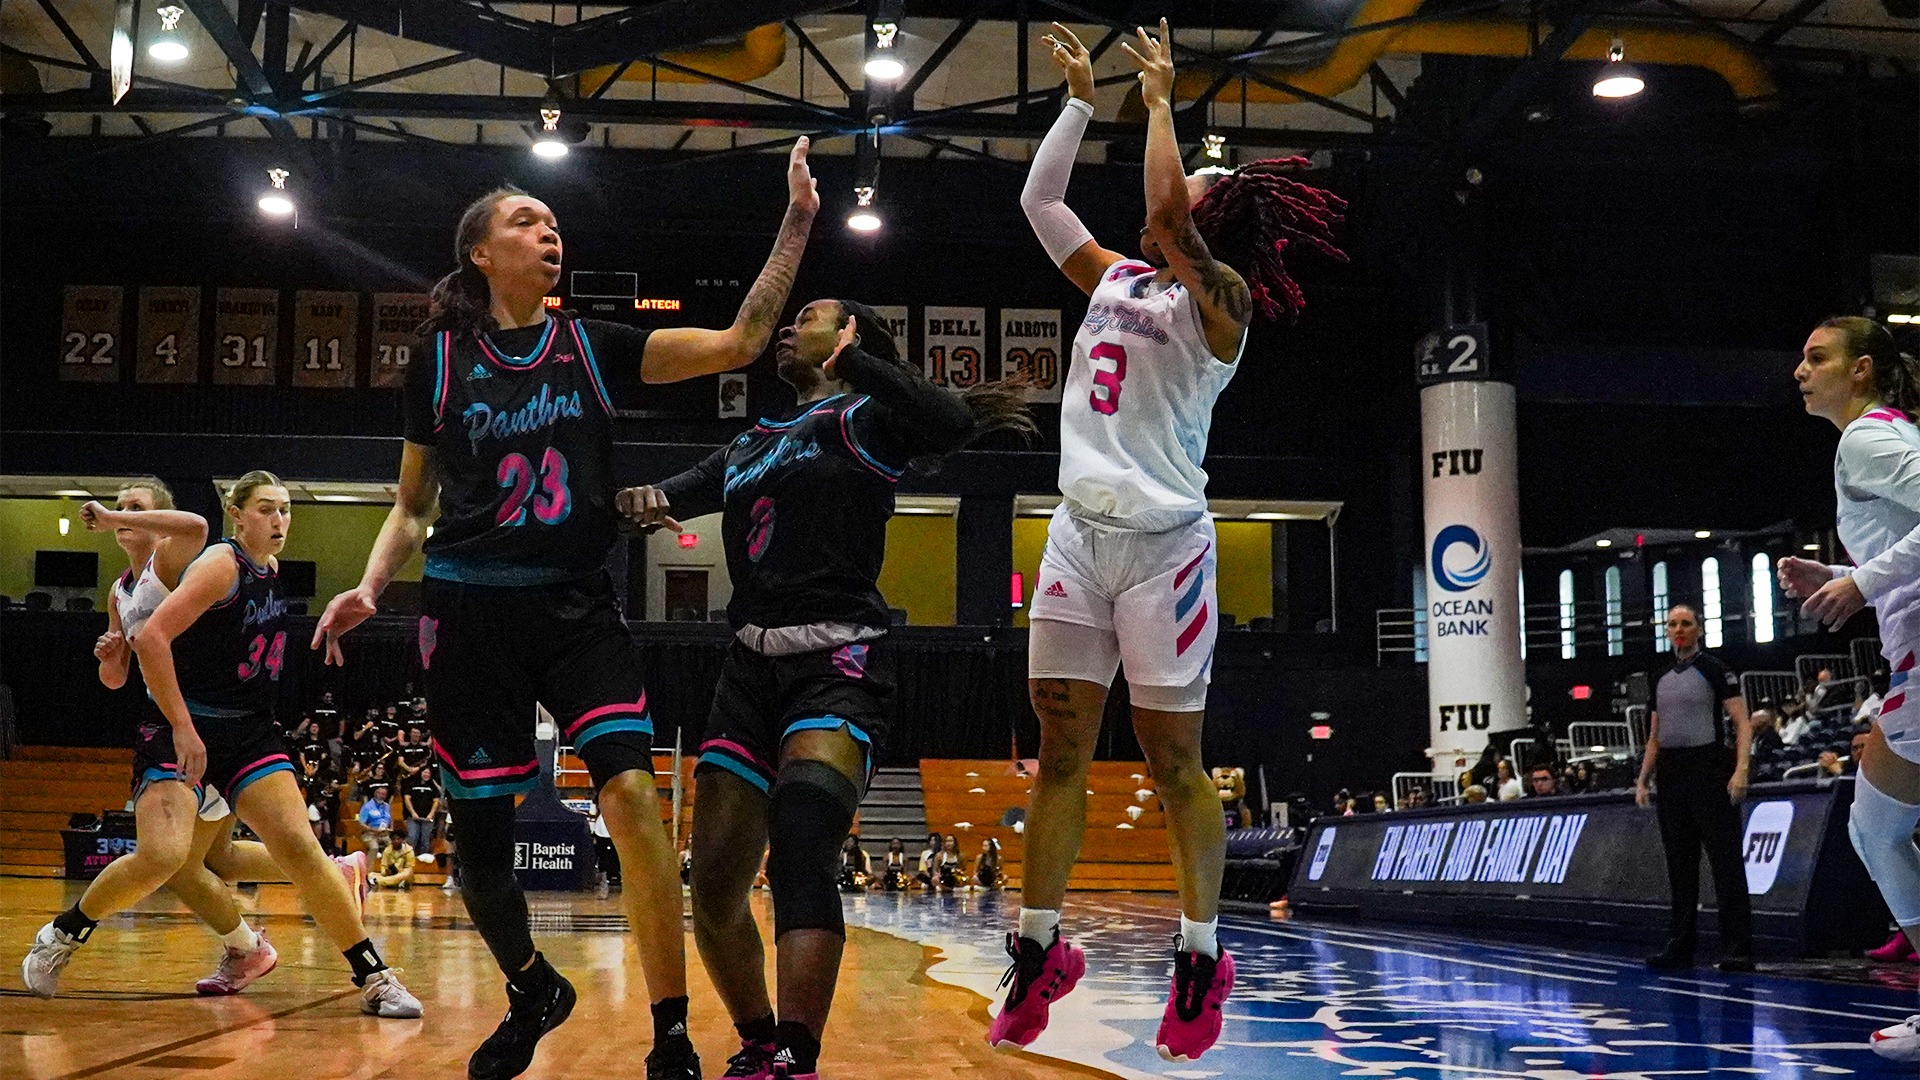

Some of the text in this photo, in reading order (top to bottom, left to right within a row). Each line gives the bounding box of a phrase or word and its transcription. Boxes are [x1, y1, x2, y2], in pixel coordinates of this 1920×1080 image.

[634, 298, 680, 310] LATECH
[928, 319, 981, 337] BELL
[1005, 321, 1058, 338] ARROYO
[64, 331, 114, 364] 22
[155, 333, 178, 365] 4
[221, 333, 267, 368] 31
[305, 338, 342, 370] 11
[1447, 334, 1478, 374] 2
[927, 345, 981, 388] 13
[1005, 347, 1057, 389] 30
[1089, 341, 1127, 416] 3
[463, 383, 583, 457] Panthrs
[1432, 448, 1483, 478] FIU
[496, 446, 572, 527] 23
[1433, 600, 1493, 617] OCEAN
[1437, 620, 1489, 637] BANK
[238, 631, 287, 681] 34
[1439, 704, 1491, 732] FIU
[532, 843, 575, 858] Baptist
[532, 858, 573, 870] Health
[1440, 820, 1486, 881] AND
[1473, 816, 1548, 882] FAMILY
[1532, 814, 1588, 884] DAY
[1743, 832, 1782, 864] FIU
